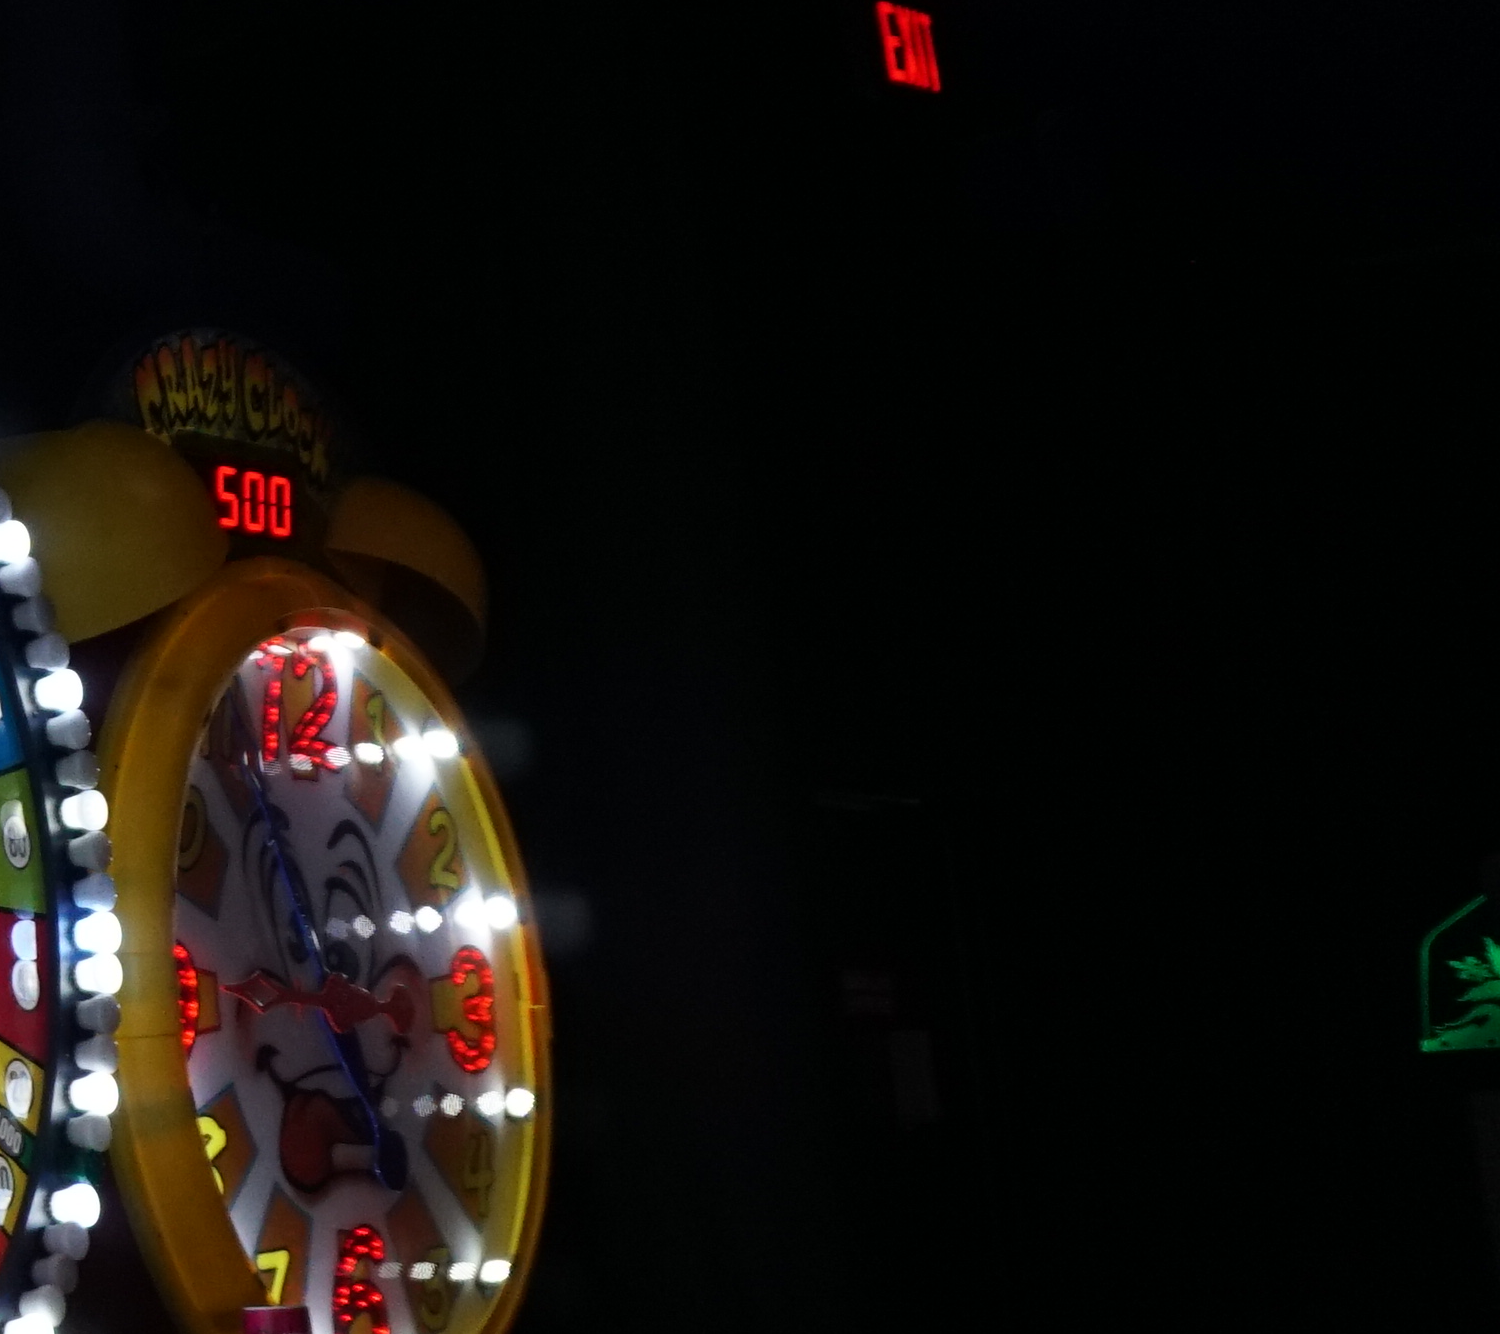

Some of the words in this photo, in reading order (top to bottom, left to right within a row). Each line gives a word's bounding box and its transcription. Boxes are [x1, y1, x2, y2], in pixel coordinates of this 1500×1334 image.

[215, 466, 291, 537] 500
[256, 637, 338, 770] 12
[449, 946, 495, 1074] 3
